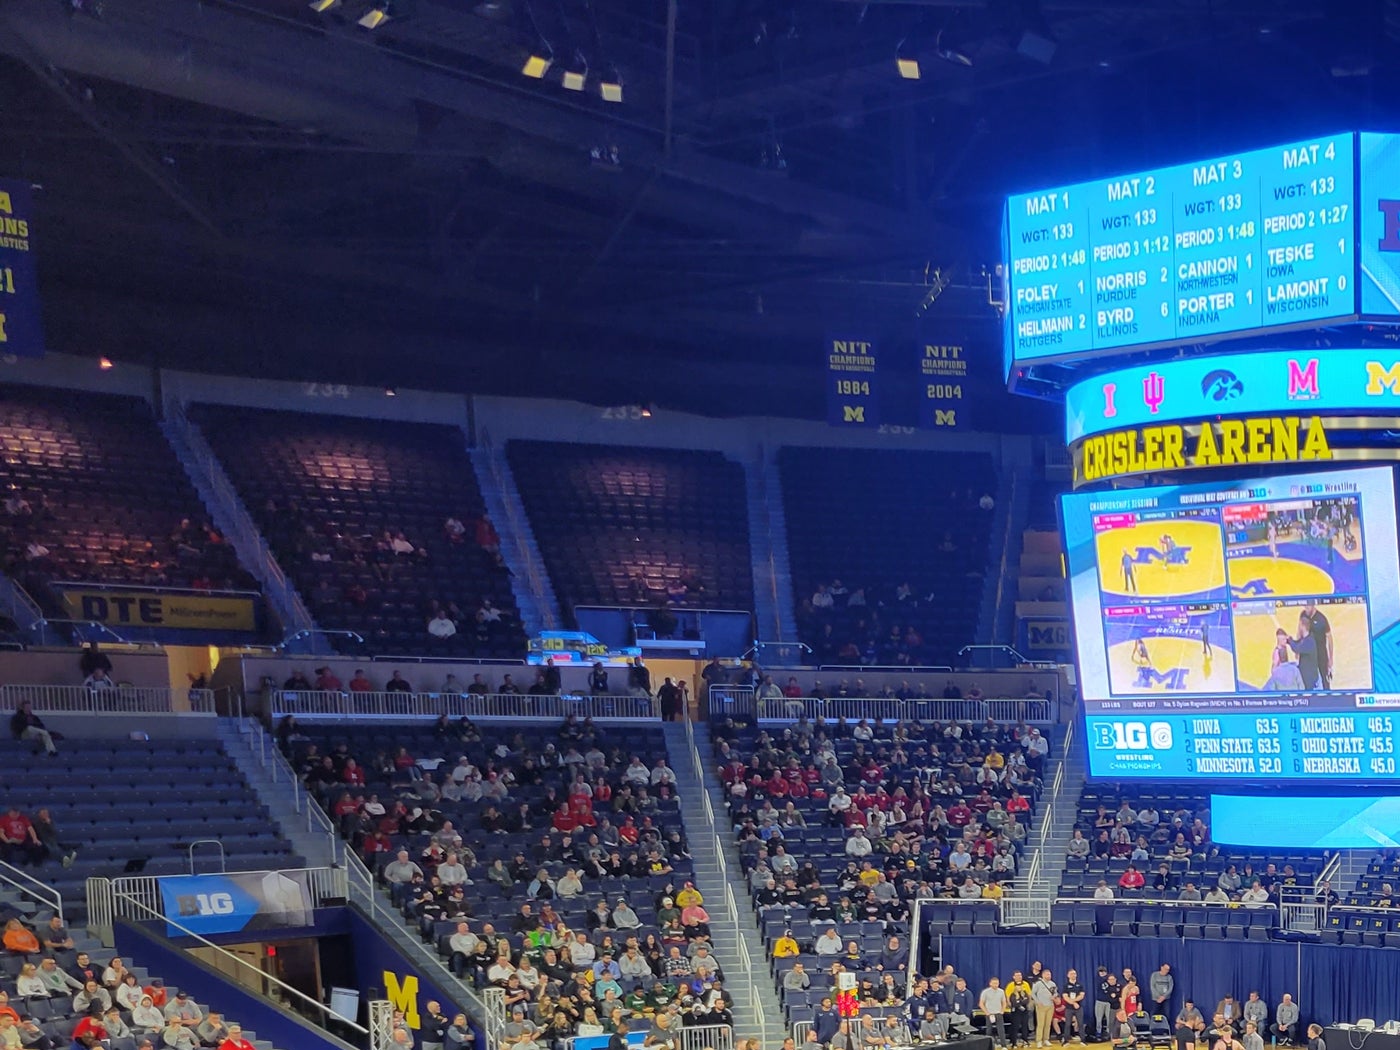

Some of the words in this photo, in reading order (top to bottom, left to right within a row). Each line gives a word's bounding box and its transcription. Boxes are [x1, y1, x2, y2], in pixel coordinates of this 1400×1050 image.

[1283, 144, 1319, 170] MAT
[1324, 142, 1336, 161] 4
[1193, 162, 1227, 186] MAT
[1233, 160, 1242, 179] 3
[1108, 179, 1140, 203] MAT
[1146, 177, 1155, 196] 2
[1274, 184, 1306, 200] WGT:
[1310, 177, 1335, 196] 133
[1026, 194, 1057, 216] MAT
[1063, 192, 1069, 209] 1
[1184, 200, 1215, 216] WGT:
[1219, 193, 1242, 212] 133
[1102, 215, 1131, 231] WGT:
[1134, 208, 1157, 226] 133
[1264, 212, 1305, 235] PERIOD
[1308, 210, 1315, 227] 2
[1319, 205, 1348, 225] 1:27
[1022, 230, 1049, 244] WGT:
[1052, 223, 1073, 241] 133
[1175, 228, 1214, 249] PERIOD
[1217, 227, 1224, 243] 3
[1227, 221, 1255, 240] 1:48
[1093, 242, 1130, 263] PERIOD
[1133, 240, 1140, 256] 3
[1143, 236, 1169, 254] 1:12
[1268, 243, 1314, 266] TESKE
[1338, 238, 1345, 254] 1
[1014, 255, 1049, 274] PERIOD
[1052, 254, 1058, 269] 2
[1061, 249, 1086, 267] 1:48
[1178, 256, 1237, 279] CANNON
[1246, 253, 1252, 269] 1
[1267, 264, 1294, 278] IOWA
[1096, 270, 1147, 292] NORRIS
[1160, 267, 1168, 282] 2
[1177, 273, 1238, 292] NORTHWESTERN
[1267, 278, 1329, 302] LAMONT
[1338, 275, 1346, 291] 0
[1017, 283, 1058, 304] FOLEY
[1078, 280, 1084, 294] 1
[1097, 288, 1137, 304] PURDUE
[1179, 292, 1234, 315] PORTER
[1246, 289, 1253, 305] 1
[1017, 300, 1050, 315] MICHIGAN
[1051, 298, 1072, 311] STATE
[1097, 307, 1134, 327] BYRD
[1160, 302, 1168, 317] 6
[1267, 296, 1329, 315] WISCONSIN
[1018, 316, 1073, 337] HEILMANN
[1079, 314, 1086, 329] 2
[1097, 323, 1138, 339] ILLINOIS
[1179, 312, 1220, 327] INDIANA
[833, 340, 871, 354] NIT
[925, 345, 963, 358] NIT
[1018, 333, 1062, 349] RUTGERS
[830, 355, 875, 366] CHAMPIONS
[922, 359, 967, 370] CHAMPIONS
[837, 380, 870, 395] 1984
[1287, 359, 1319, 395] M
[927, 385, 962, 399] 2004
[1082, 425, 1185, 481] CRISLER
[1194, 416, 1333, 465] ARENA
[81, 595, 164, 624] DTE
[1193, 719, 1221, 734] IOWA
[1256, 718, 1279, 734] 63.5
[1300, 717, 1355, 734] MICHIGAN
[1368, 716, 1392, 733] 46.5
[1195, 739, 1221, 754] PENN
[1222, 738, 1253, 754] STATE
[1258, 738, 1281, 754] 63.5
[1302, 738, 1328, 754] OHIO
[1329, 737, 1365, 753] STATE
[1369, 737, 1394, 753] 45.5
[1196, 758, 1256, 774] MINNESOTA
[1259, 758, 1282, 773] 52.0
[1304, 758, 1361, 773] NEBRASKA
[1370, 758, 1395, 773] 45.0
[383, 970, 421, 1029] M
